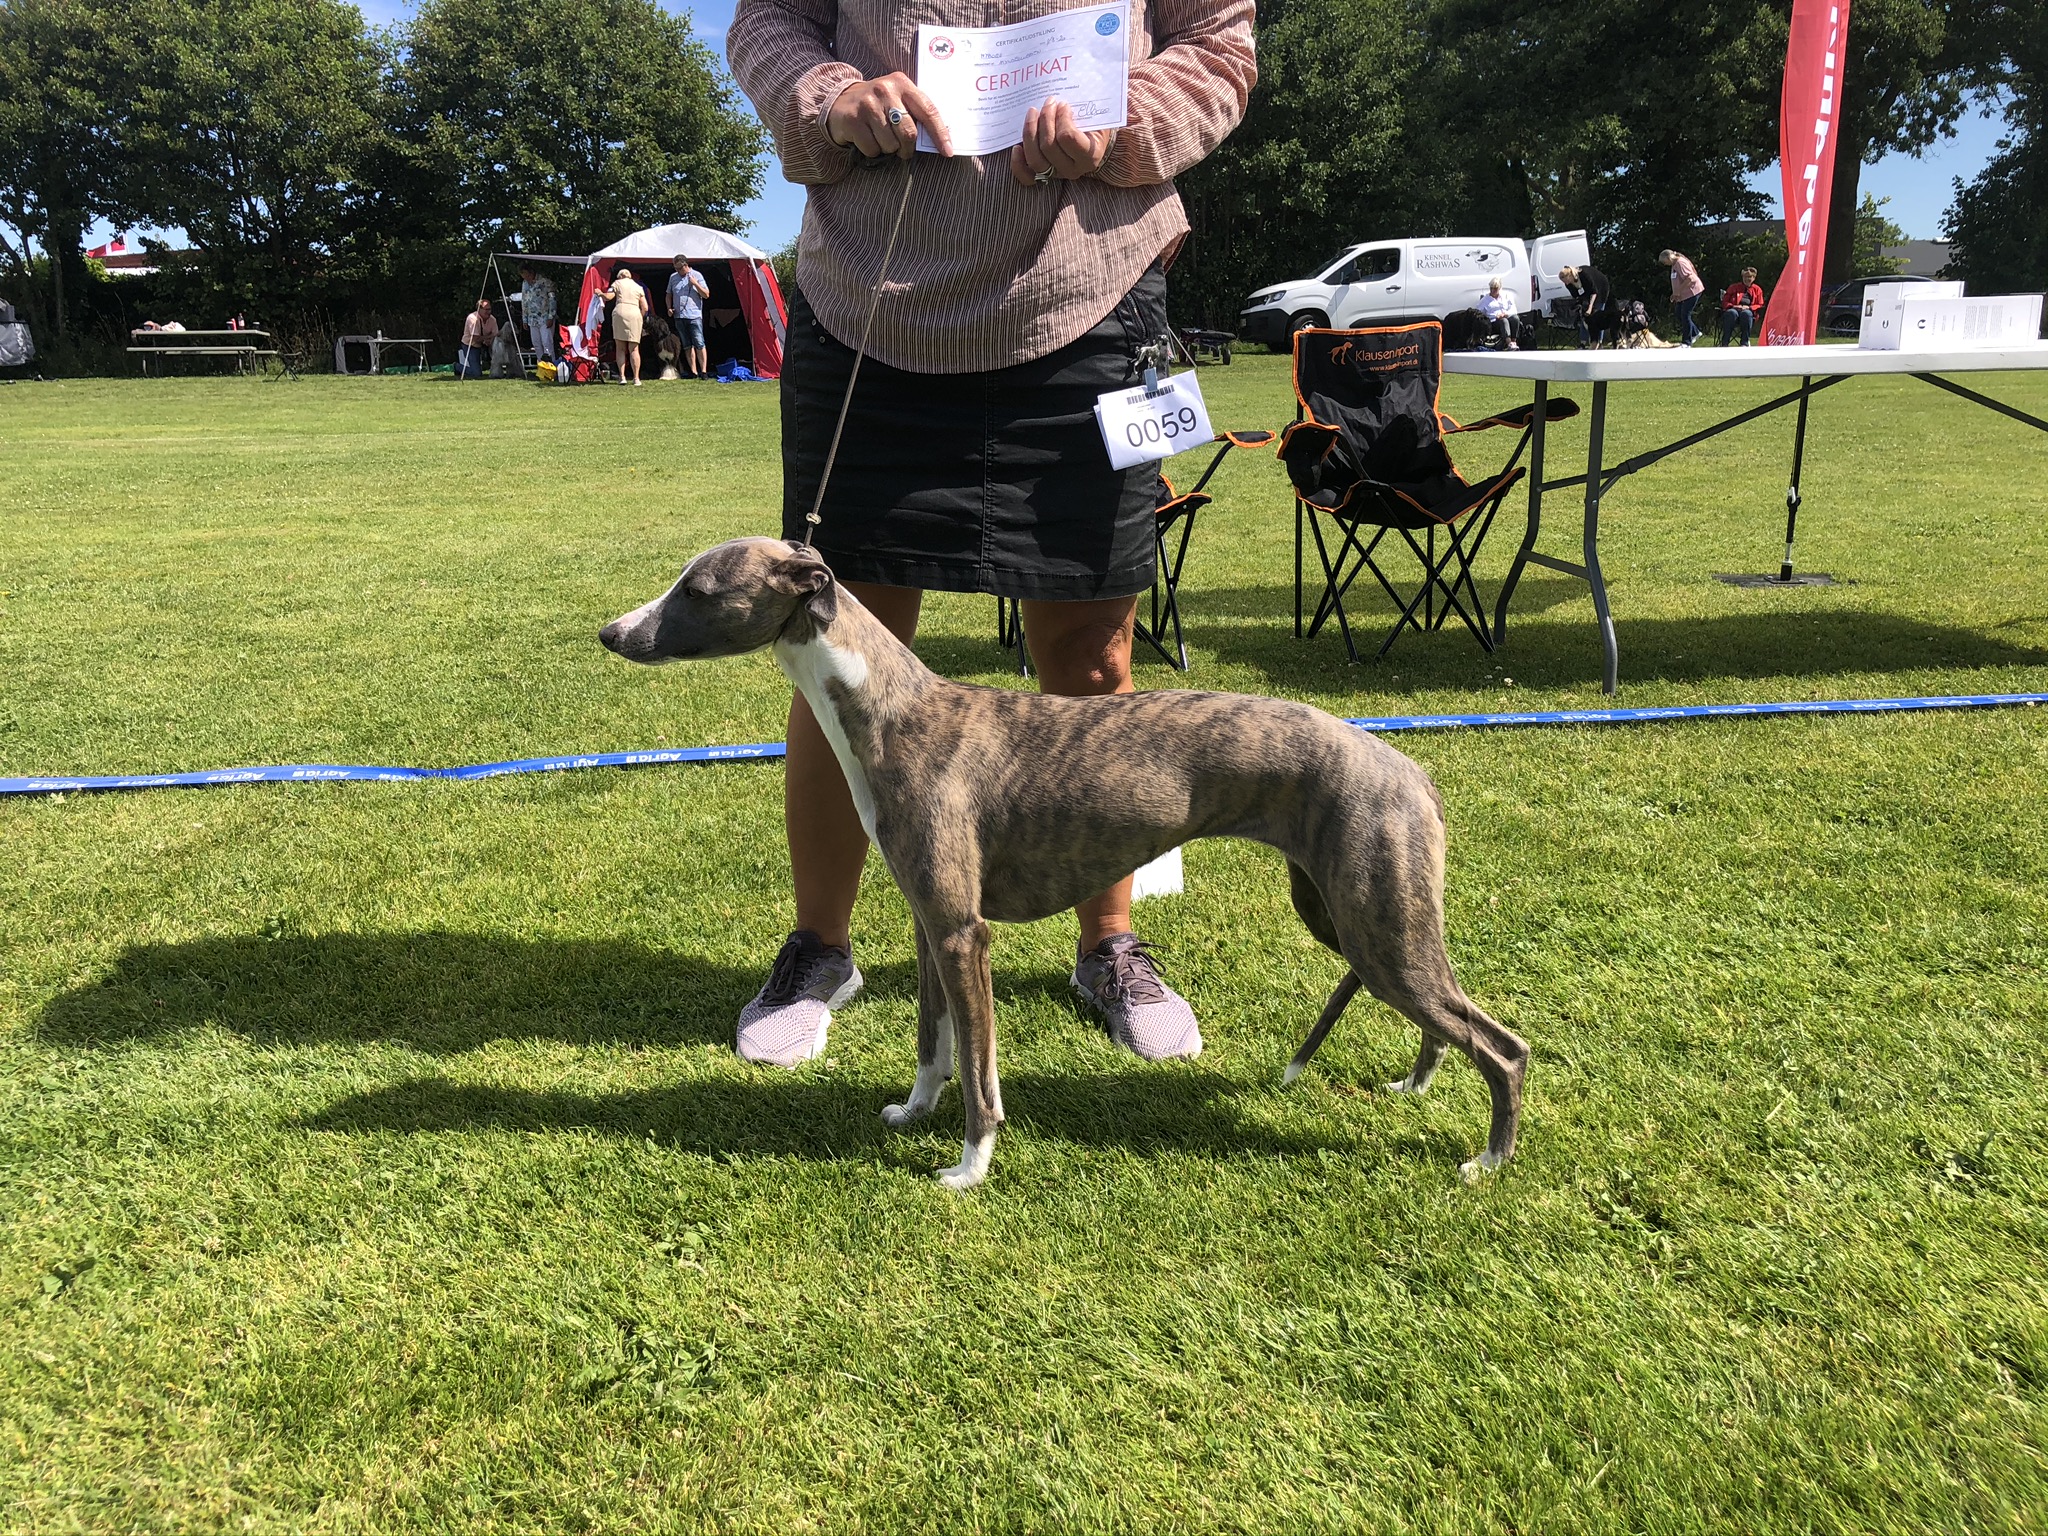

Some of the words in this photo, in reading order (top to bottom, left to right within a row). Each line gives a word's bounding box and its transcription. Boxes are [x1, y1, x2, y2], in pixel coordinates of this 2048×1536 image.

[995, 27, 1056, 47] CERTIFIKATUDSTILLING
[975, 55, 1073, 92] CERTIFIKAT
[1416, 258, 1461, 269] RASHWAS
[1126, 407, 1197, 447] 0059
